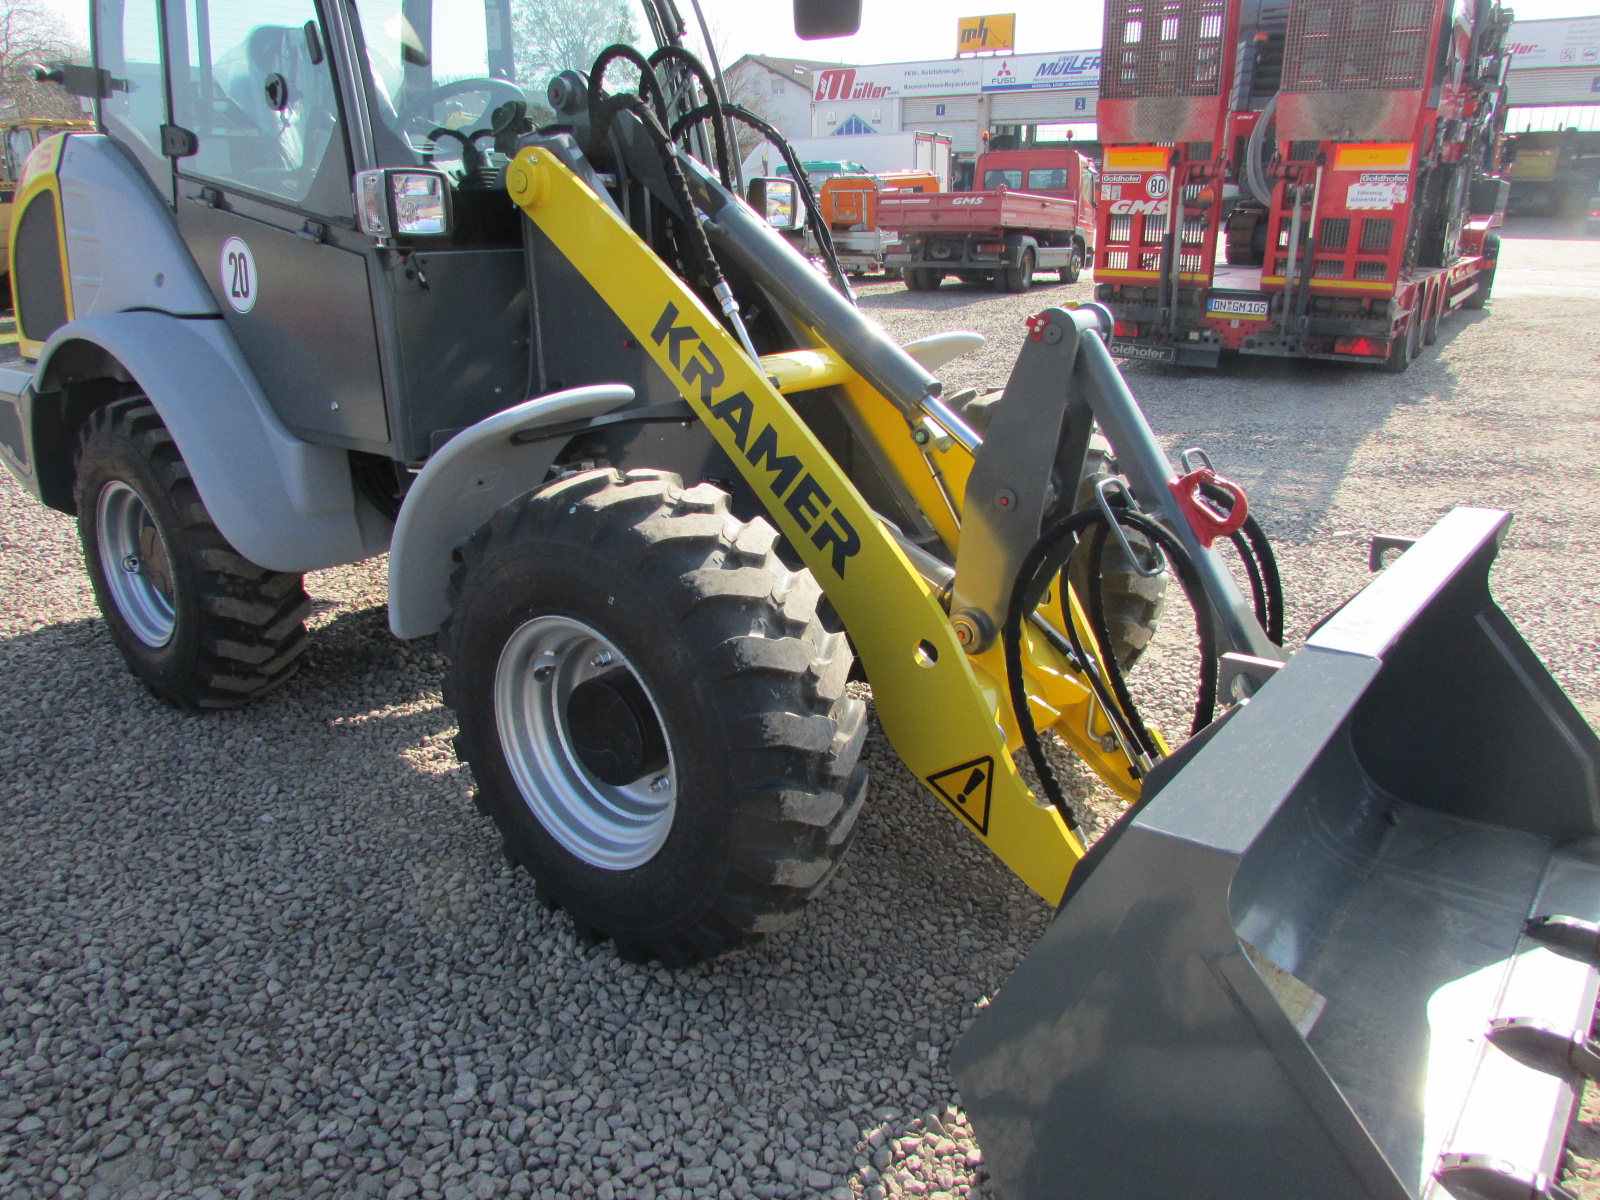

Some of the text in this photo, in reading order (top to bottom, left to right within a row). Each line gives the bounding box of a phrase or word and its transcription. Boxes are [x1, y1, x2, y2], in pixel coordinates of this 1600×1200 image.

[815, 68, 892, 101] Müller
[1150, 178, 1166, 194] 80
[952, 197, 984, 205] GMS
[1109, 199, 1169, 215] GMS
[229, 252, 250, 298] 20
[1213, 300, 1267, 313] DN GM 105
[1111, 344, 1165, 359] oldhofer
[651, 301, 861, 579] KRAMER
